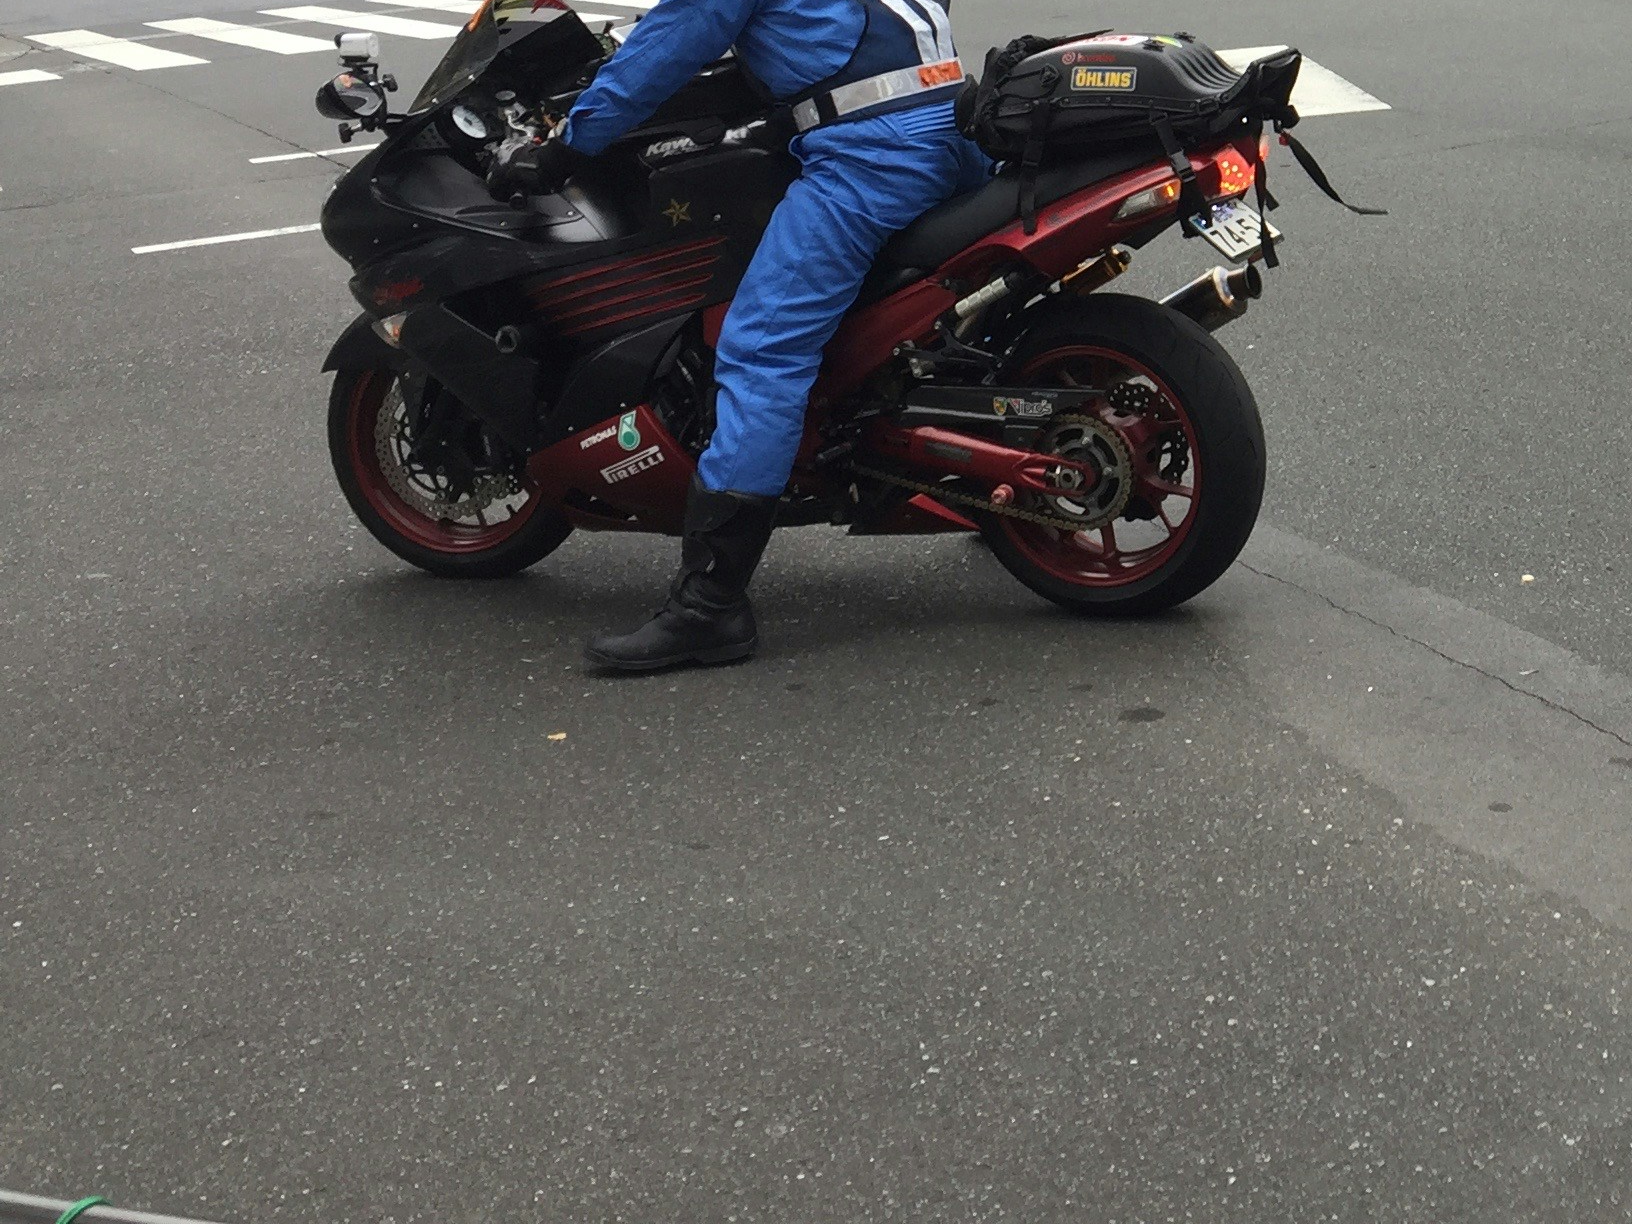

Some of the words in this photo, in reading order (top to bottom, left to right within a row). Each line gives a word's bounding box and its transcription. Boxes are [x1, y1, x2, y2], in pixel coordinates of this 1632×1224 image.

[1075, 66, 1132, 87] ÖHLINS
[579, 424, 617, 451] PETRONAS
[601, 444, 665, 485] PIRELLI
